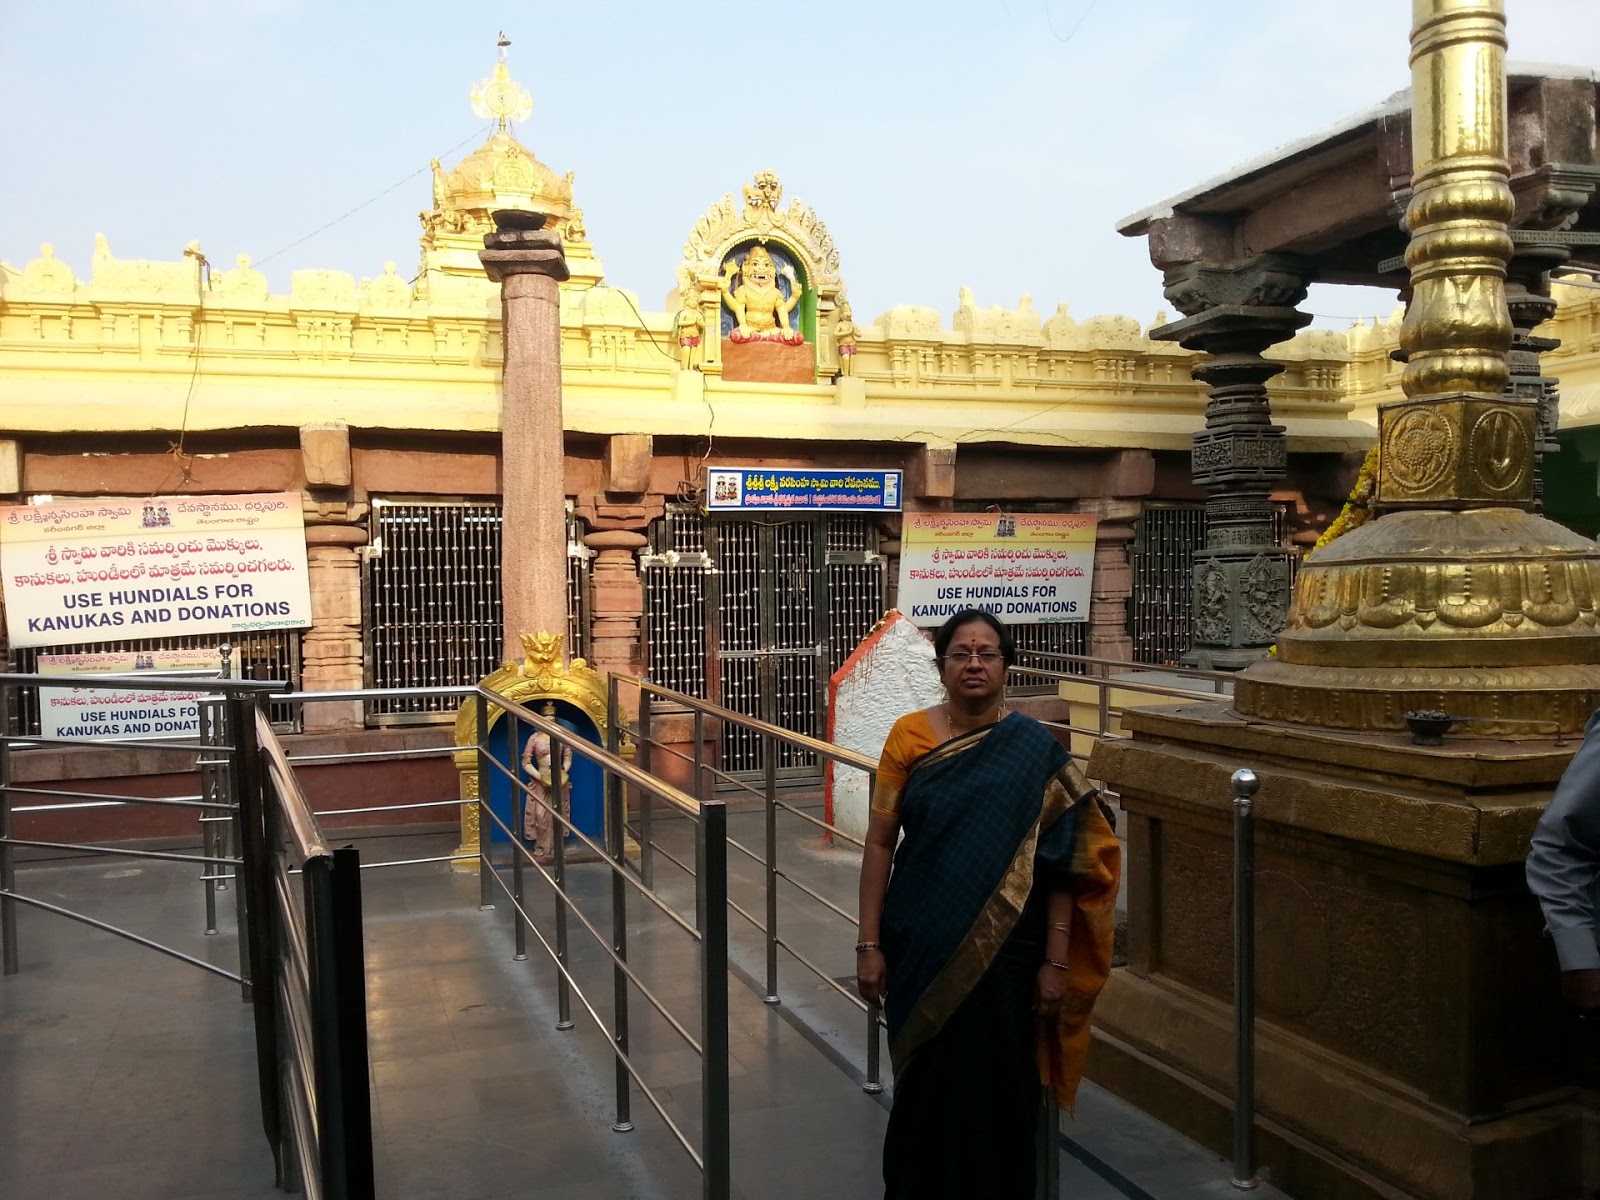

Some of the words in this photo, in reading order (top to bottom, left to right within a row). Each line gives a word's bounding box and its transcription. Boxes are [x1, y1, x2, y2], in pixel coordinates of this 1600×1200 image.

[765, 474, 779, 492] లక్ష్మీ
[779, 476, 810, 488] నరసింహ
[810, 477, 829, 491] స్వామి
[829, 477, 844, 488] వారి
[7, 509, 20, 525] శ్రీ
[23, 508, 95, 524] లక్ష్మీనృసింహ
[97, 506, 132, 520] స్వామి
[196, 517, 235, 525] తెలంగాణ
[914, 519, 922, 528] శ్రీ
[923, 518, 969, 530] లక్ష్మీనృసింహ
[970, 519, 992, 528] స్వామి
[45, 546, 59, 565] శ్రీ
[60, 544, 97, 565] స్వామి
[100, 540, 136, 558] వారికి
[138, 538, 203, 560] సమర్పించు
[931, 548, 940, 563] శ్రీ
[941, 549, 966, 564] స్వామి
[966, 548, 990, 559] వారికి
[990, 548, 1032, 563] సమర్పించు
[76, 564, 147, 584] హుండీలలో
[148, 560, 196, 581] మాత్రమే
[198, 557, 295, 579] సమర్పించగలరు.
[948, 565, 993, 579] హుండీలలో
[993, 565, 1024, 581] మాత్రమే
[1025, 566, 1085, 581] సమర్పించగలరు.
[63, 591, 103, 609] USE
[108, 585, 209, 606] HUNDIALS
[215, 583, 254, 599] FOR
[937, 587, 962, 599] USE
[966, 586, 1029, 599] HUNDIALS
[1032, 585, 1057, 598] FOR
[978, 603, 1003, 614] AND
[1006, 600, 1077, 614] DONATIONS
[28, 610, 125, 633] KANUKAS
[130, 607, 173, 624] AND
[178, 600, 291, 622] DONATIONS
[50, 657, 59, 666] శ్రీ
[106, 653, 129, 664] స్వామి
[90, 692, 135, 705] హుండీలలో
[136, 690, 168, 706] మాత్రమే
[80, 711, 107, 722] USE
[110, 707, 176, 721] HUNDIALS
[180, 706, 202, 717] FO
[56, 724, 120, 737] KANUKAS
[123, 722, 151, 734] AND
